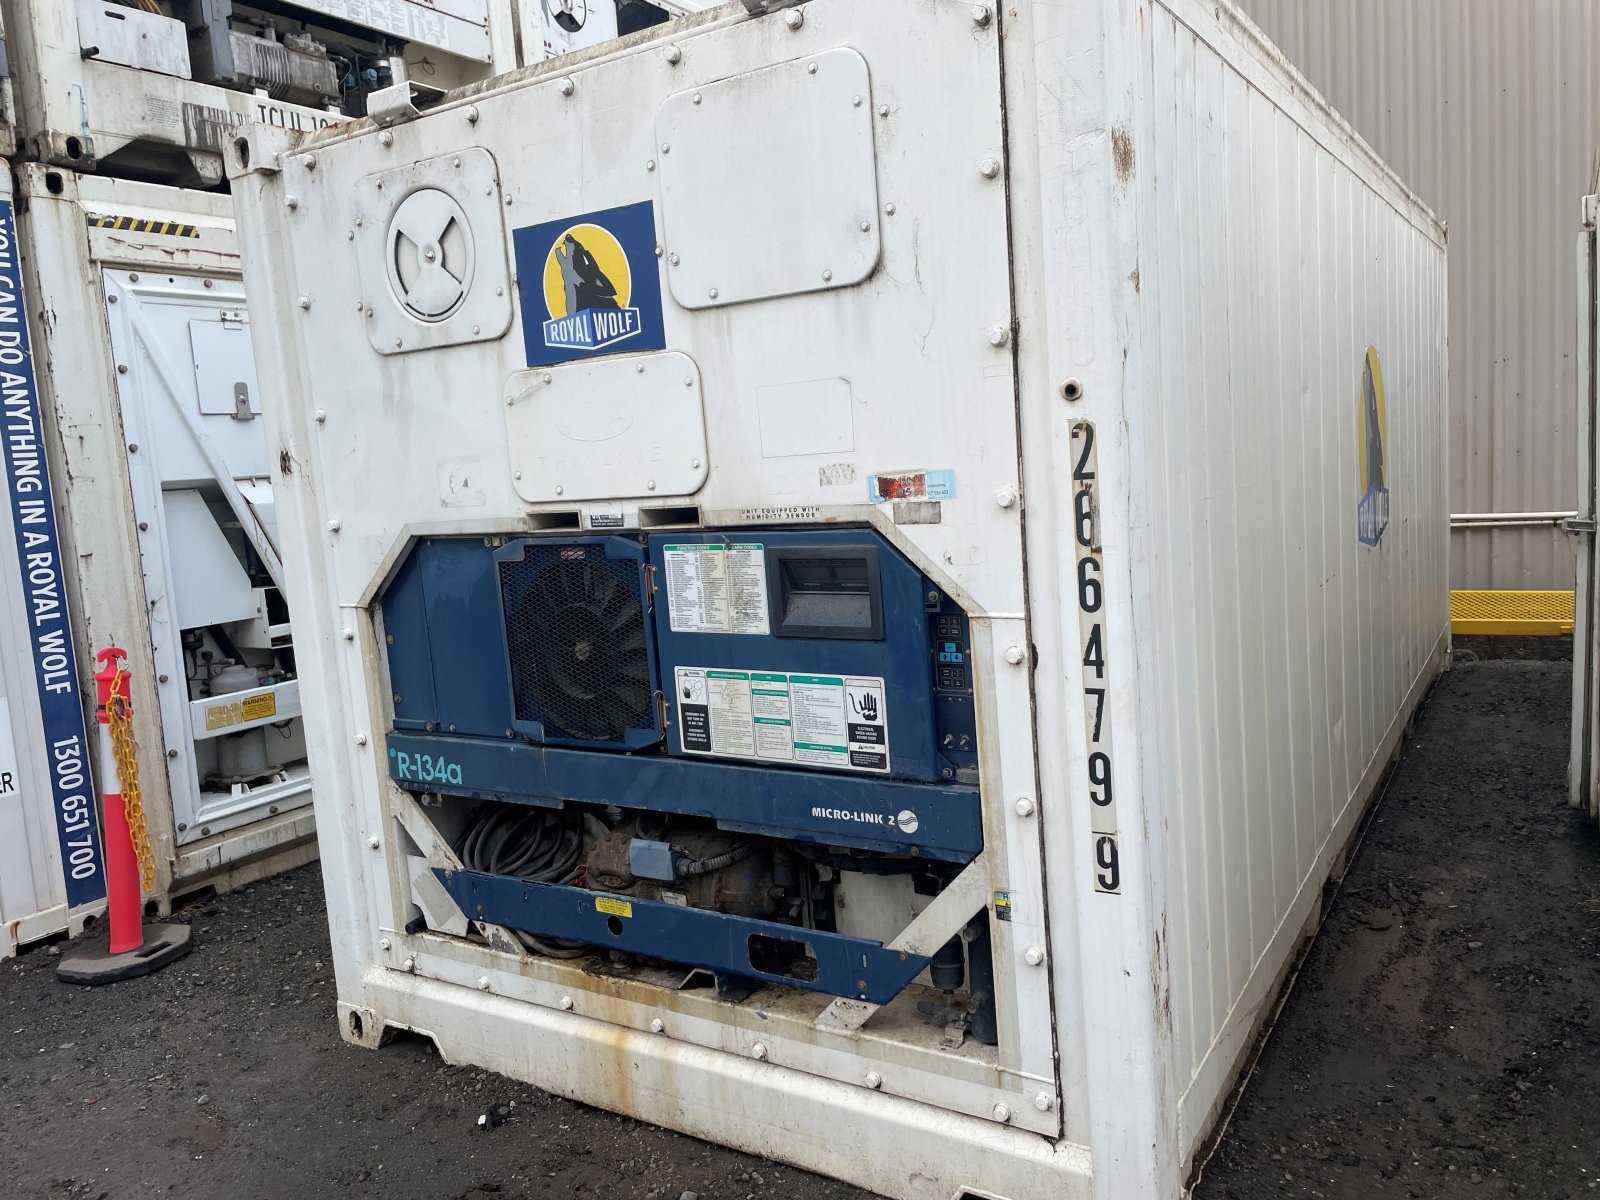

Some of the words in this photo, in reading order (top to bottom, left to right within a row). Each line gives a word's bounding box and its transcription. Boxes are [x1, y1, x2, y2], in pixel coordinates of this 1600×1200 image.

[550, 314, 592, 343] ROYAL
[593, 312, 633, 341] WOLF
[0, 331, 24, 365] DO
[1, 371, 43, 493] ANYTHING
[19, 499, 47, 525] IN
[23, 532, 50, 549] A
[26, 553, 62, 628] ROYAL
[38, 629, 72, 695] WOLF
[53, 734, 83, 790] 1300
[398, 750, 463, 785] R-134a
[0, 771, 15, 794] R
[62, 793, 90, 833] 651
[811, 806, 884, 824] MICRO-LINK
[888, 815, 896, 826] 2
[67, 834, 97, 880] 700
